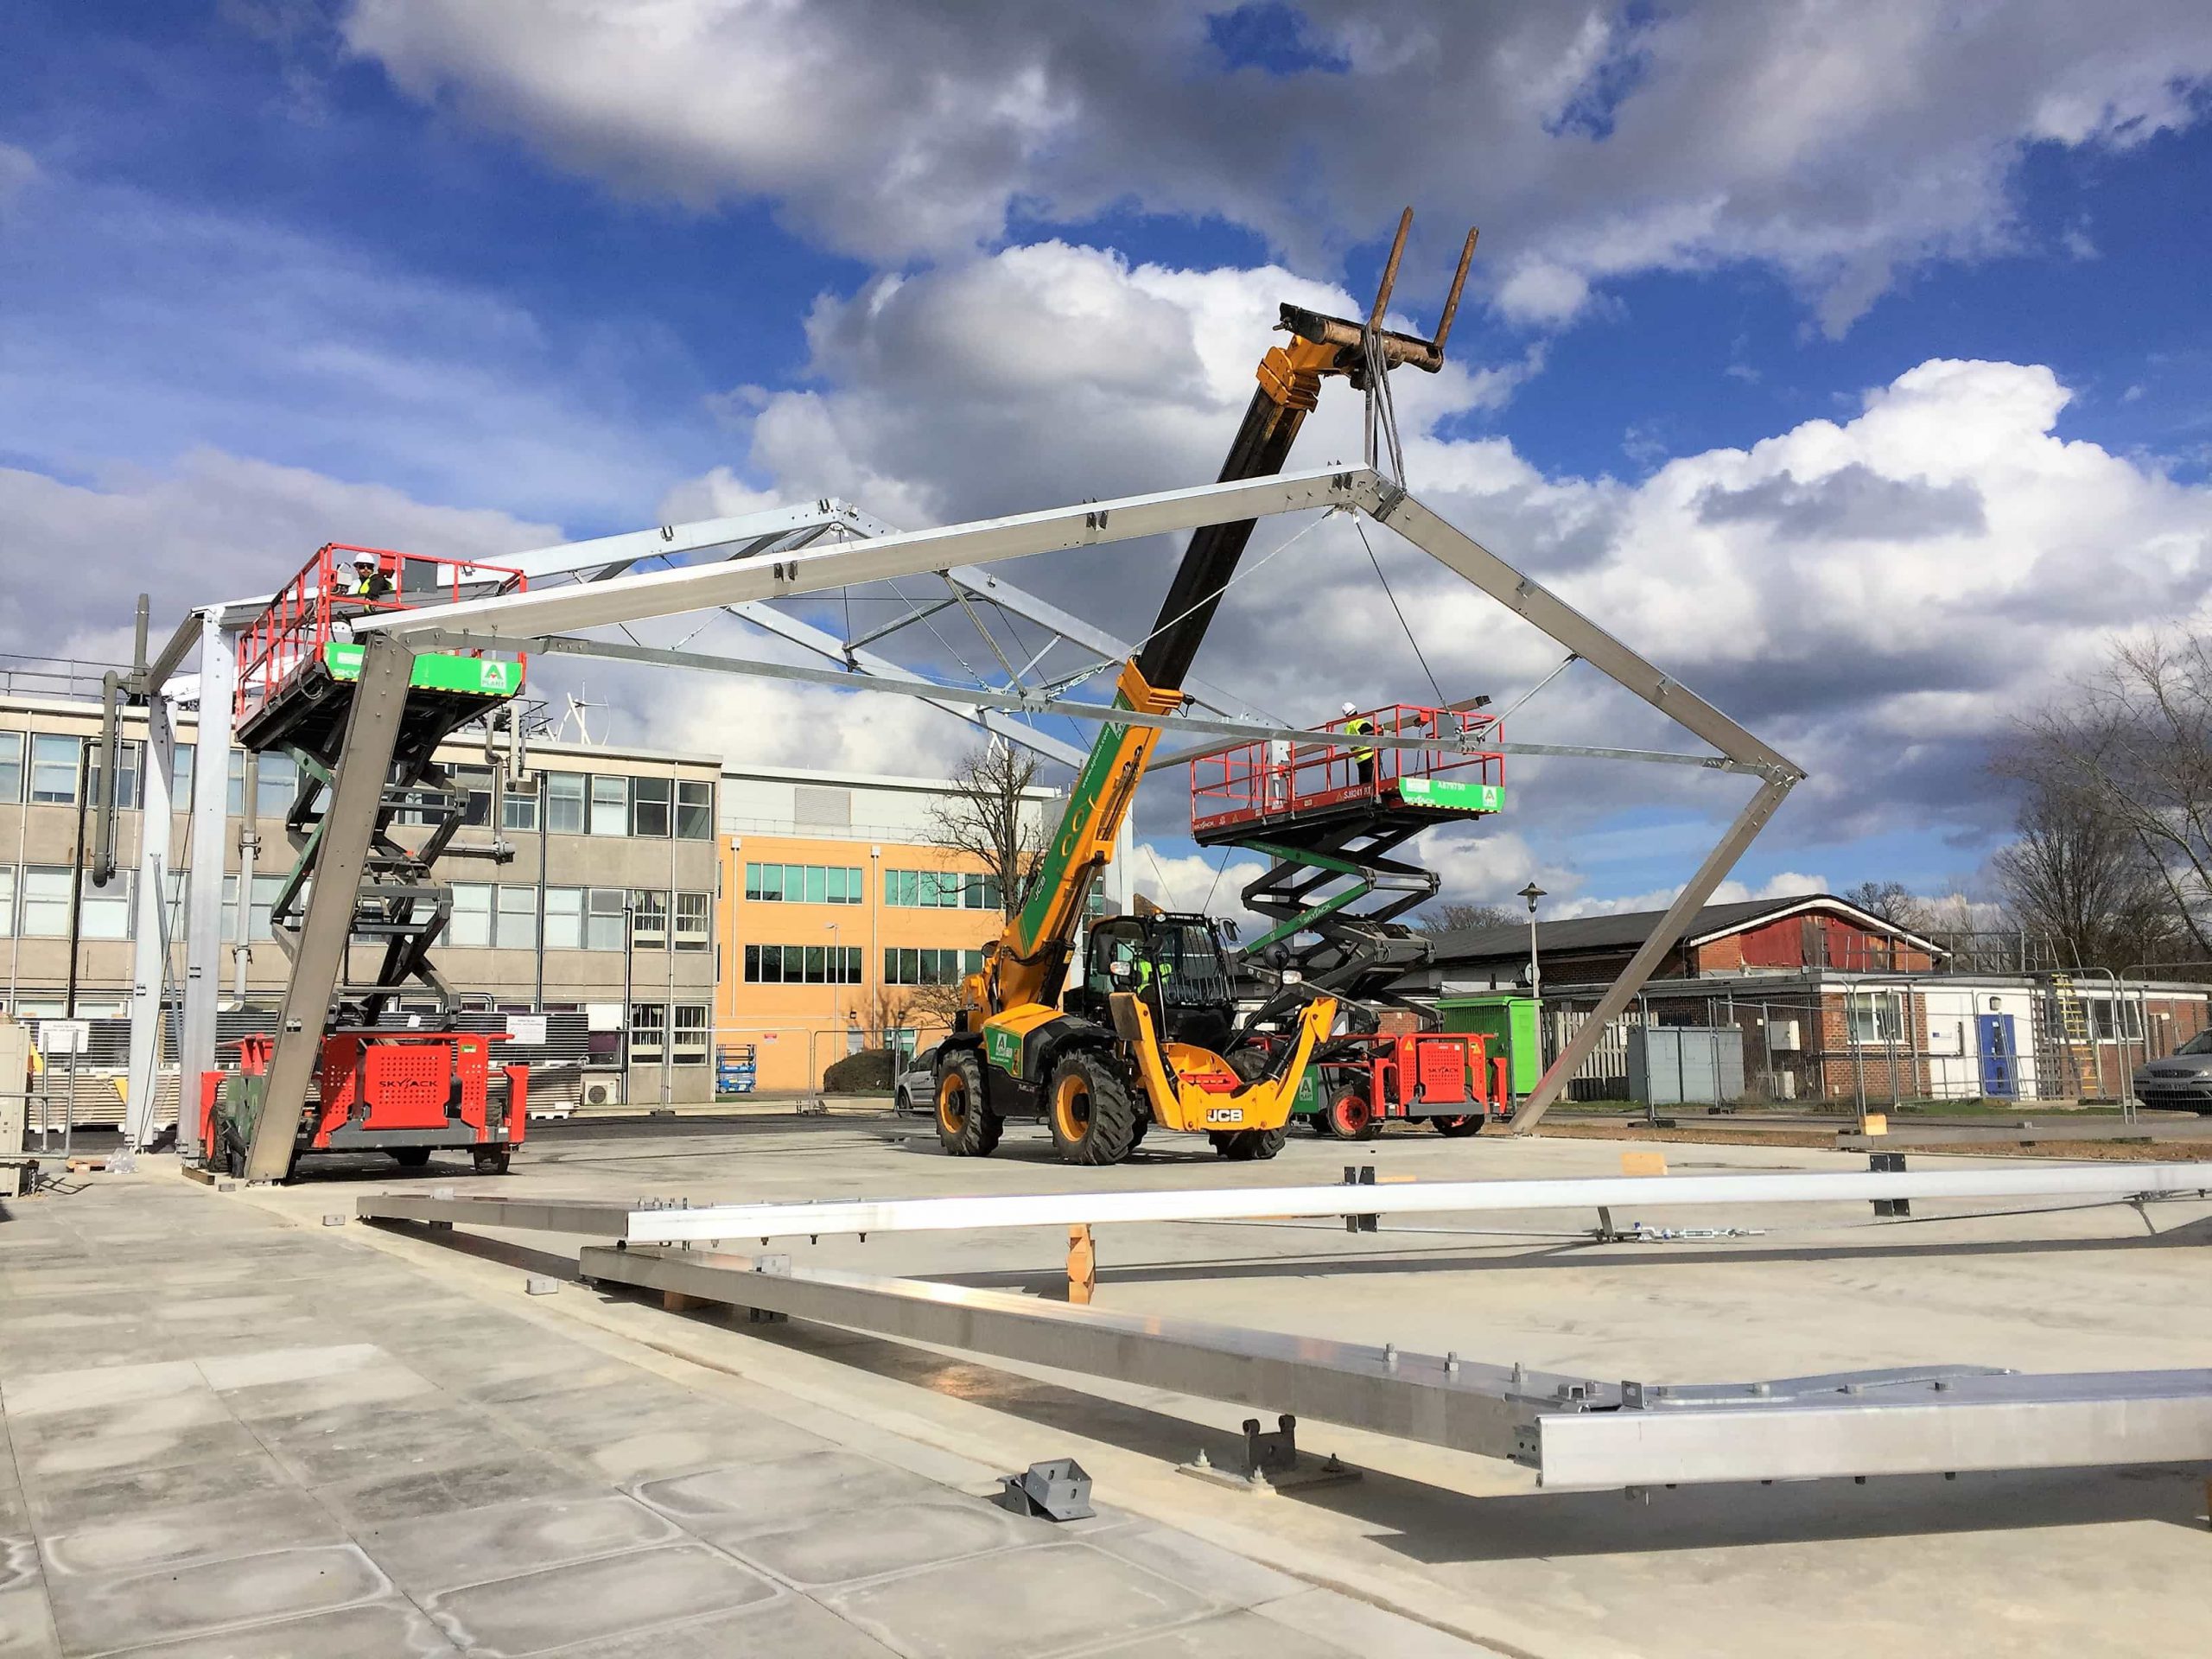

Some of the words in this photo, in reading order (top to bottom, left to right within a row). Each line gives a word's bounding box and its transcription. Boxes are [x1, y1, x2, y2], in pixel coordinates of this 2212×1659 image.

[1035, 875, 1046, 901] JCB
[378, 1077, 439, 1089] SKYJACK
[1206, 1109, 1243, 1122] JCB
